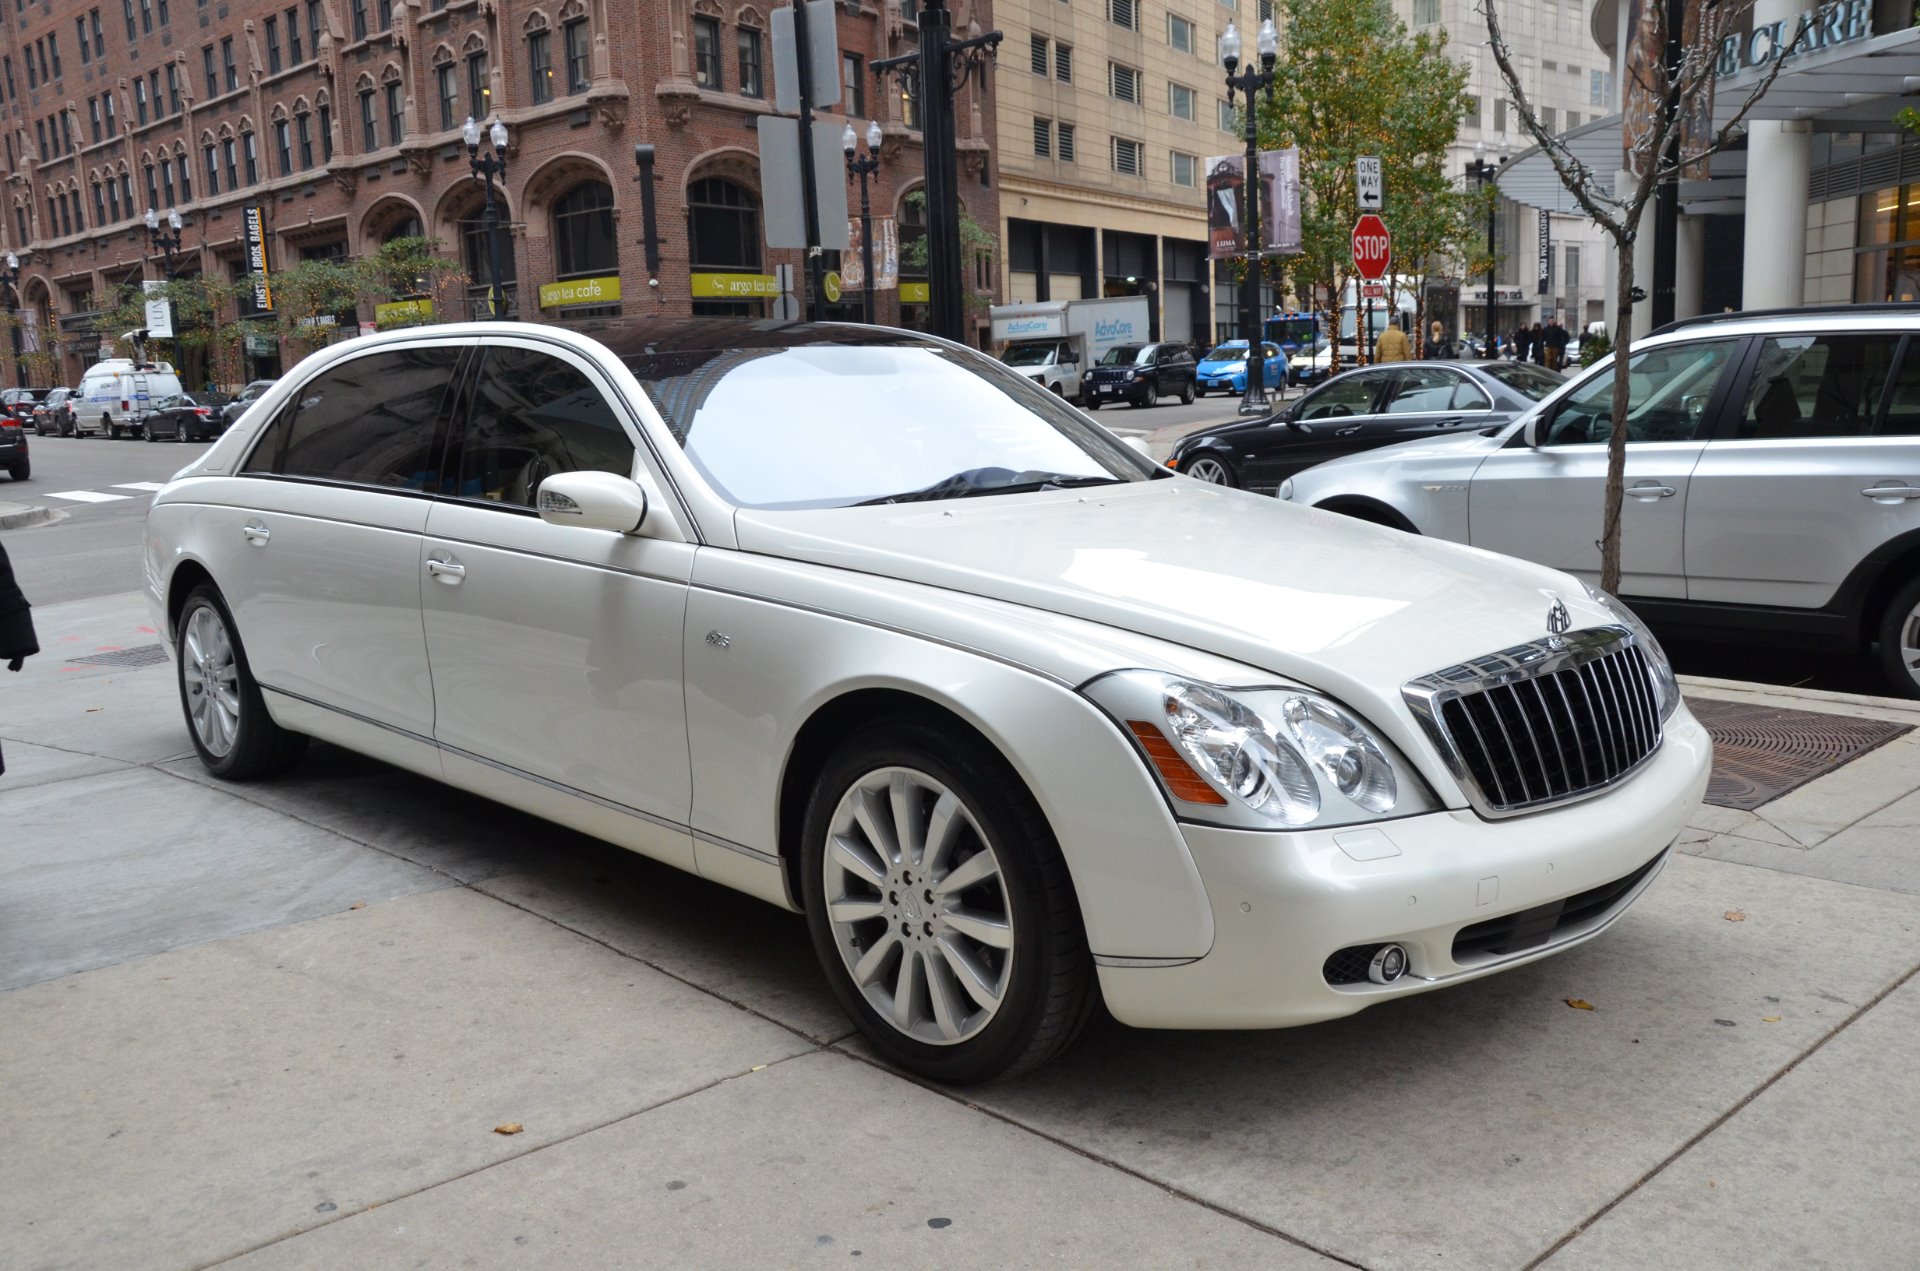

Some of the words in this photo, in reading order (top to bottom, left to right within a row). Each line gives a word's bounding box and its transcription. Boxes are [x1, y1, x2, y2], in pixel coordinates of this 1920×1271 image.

[1749, 0, 1873, 68] CLARE
[1360, 161, 1379, 174] ONE
[1360, 175, 1379, 188] WAY
[247, 208, 261, 242] BAGELS
[1539, 209, 1548, 257] ORDSTROM
[1355, 235, 1388, 260] STOP
[1539, 258, 1549, 280] rack
[253, 270, 268, 309] EINSTN
[562, 288, 574, 299] tea
[576, 280, 602, 298] café
[730, 280, 752, 295] argo
[754, 280, 765, 292] tea
[1008, 321, 1048, 333] AdvaCare
[1096, 319, 1132, 337] AdvaCare
